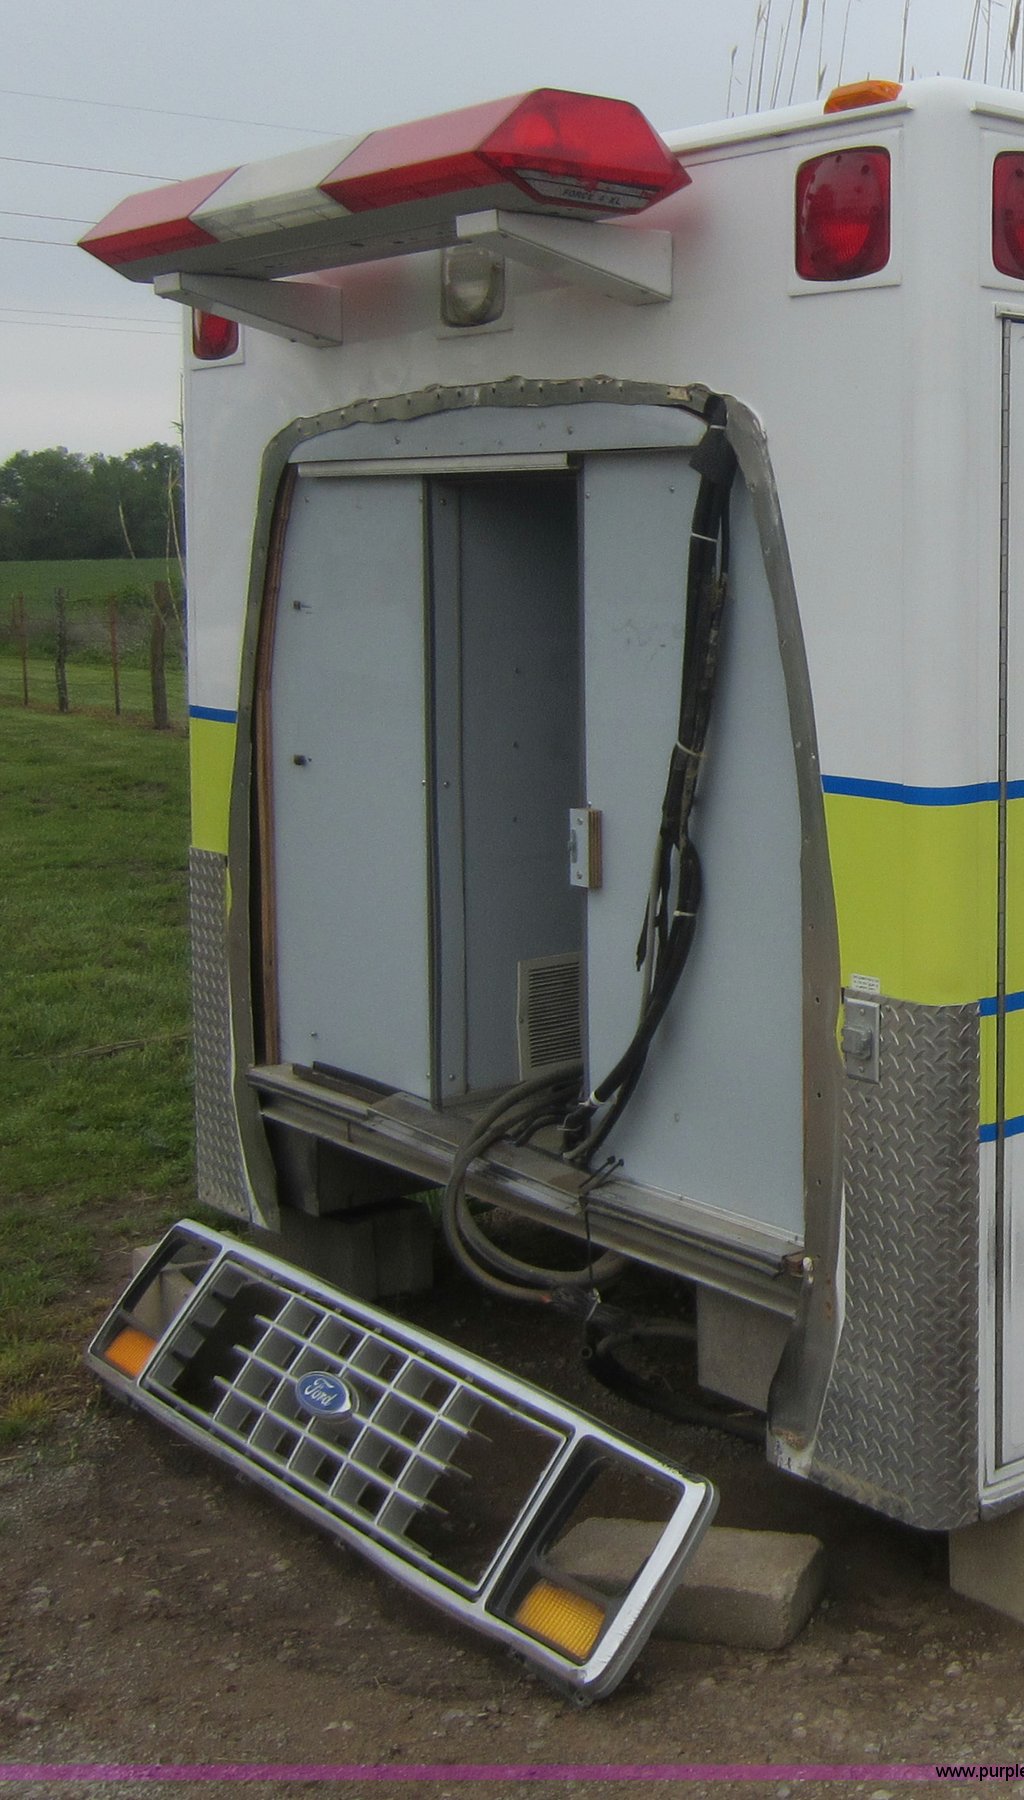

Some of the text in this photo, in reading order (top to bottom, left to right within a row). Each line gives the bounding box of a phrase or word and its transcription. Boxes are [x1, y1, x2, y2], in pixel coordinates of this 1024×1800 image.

[562, 188, 593, 201] FORCE
[608, 195, 623, 206] XL
[304, 1378, 338, 1406] Ford
